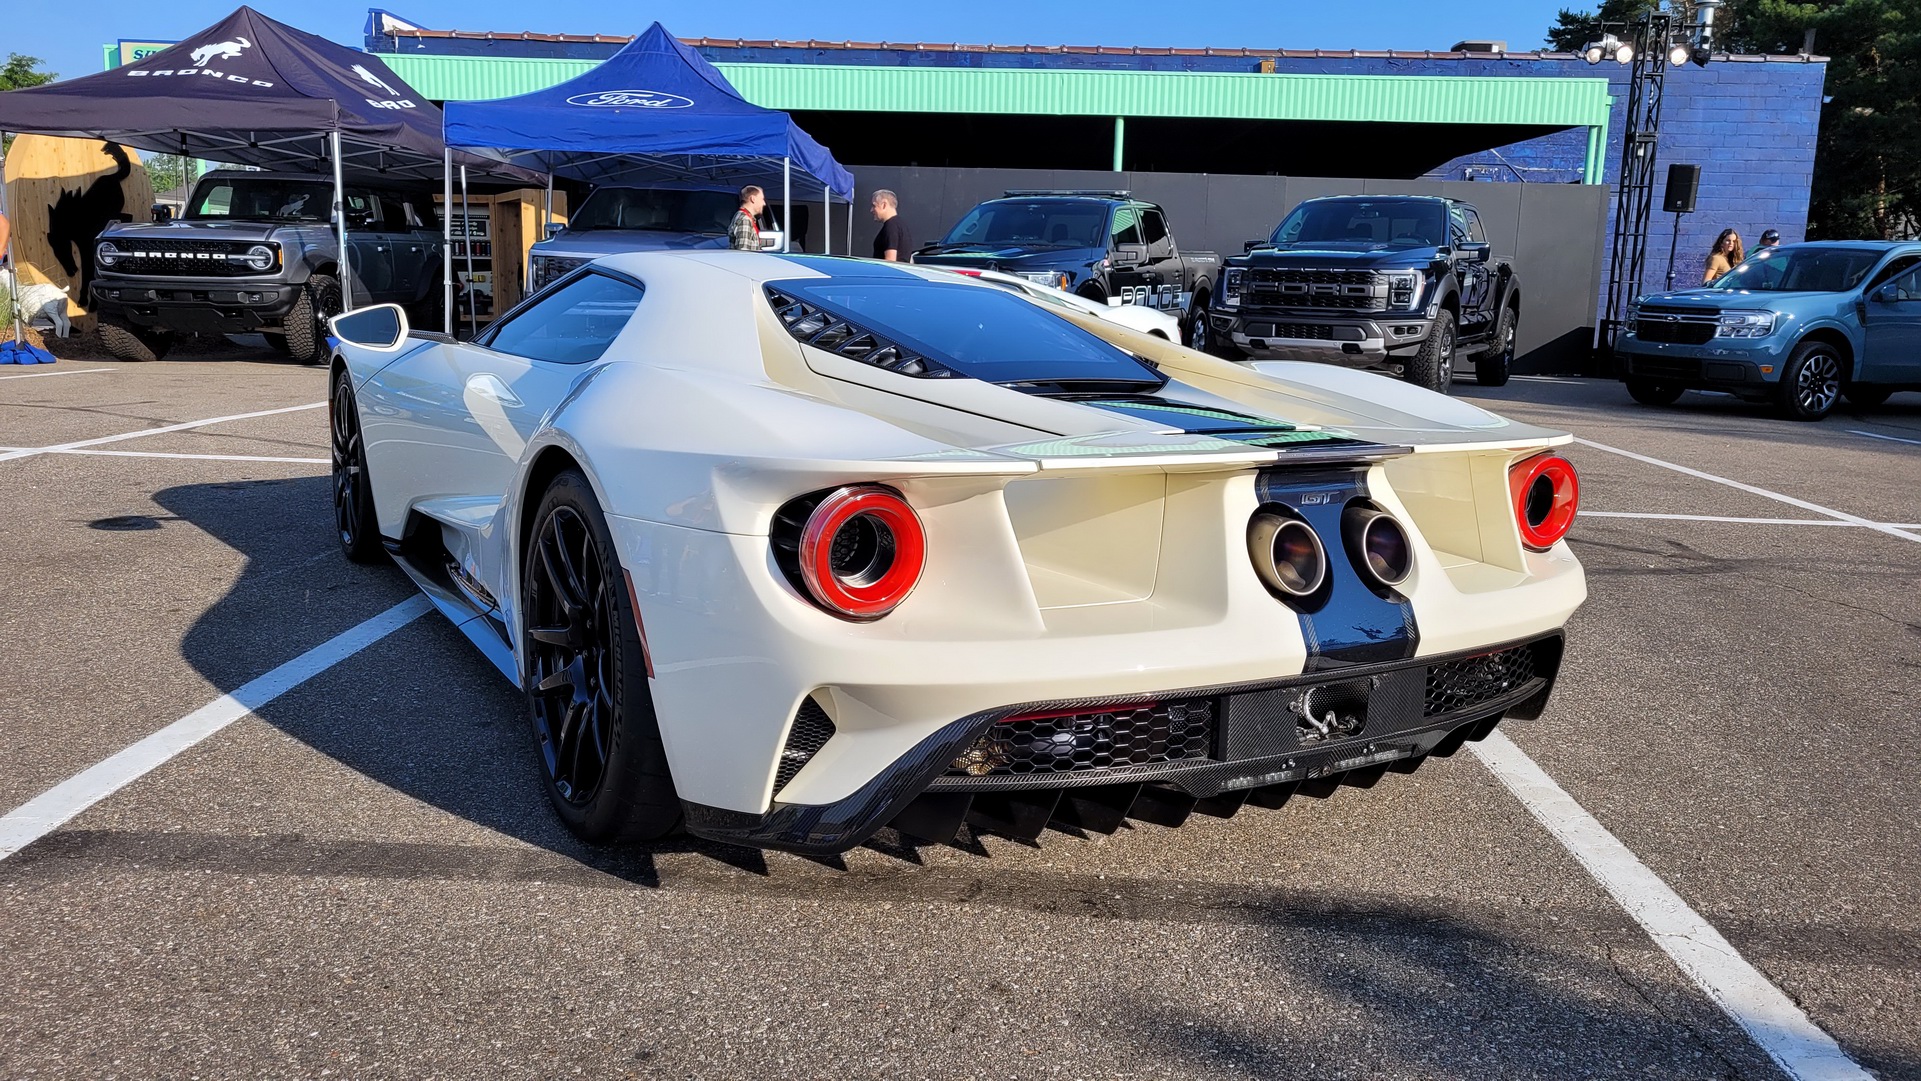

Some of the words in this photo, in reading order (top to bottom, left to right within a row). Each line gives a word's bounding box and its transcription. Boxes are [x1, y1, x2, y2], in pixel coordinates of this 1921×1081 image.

[127, 69, 274, 88] BRONCO
[586, 92, 674, 107] Ford
[133, 251, 226, 260] BRONCO
[1121, 284, 1183, 310] POLICE
[1248, 281, 1375, 297] FORD
[1301, 491, 1341, 506] GT
[612, 610, 624, 705] MICHELIN
